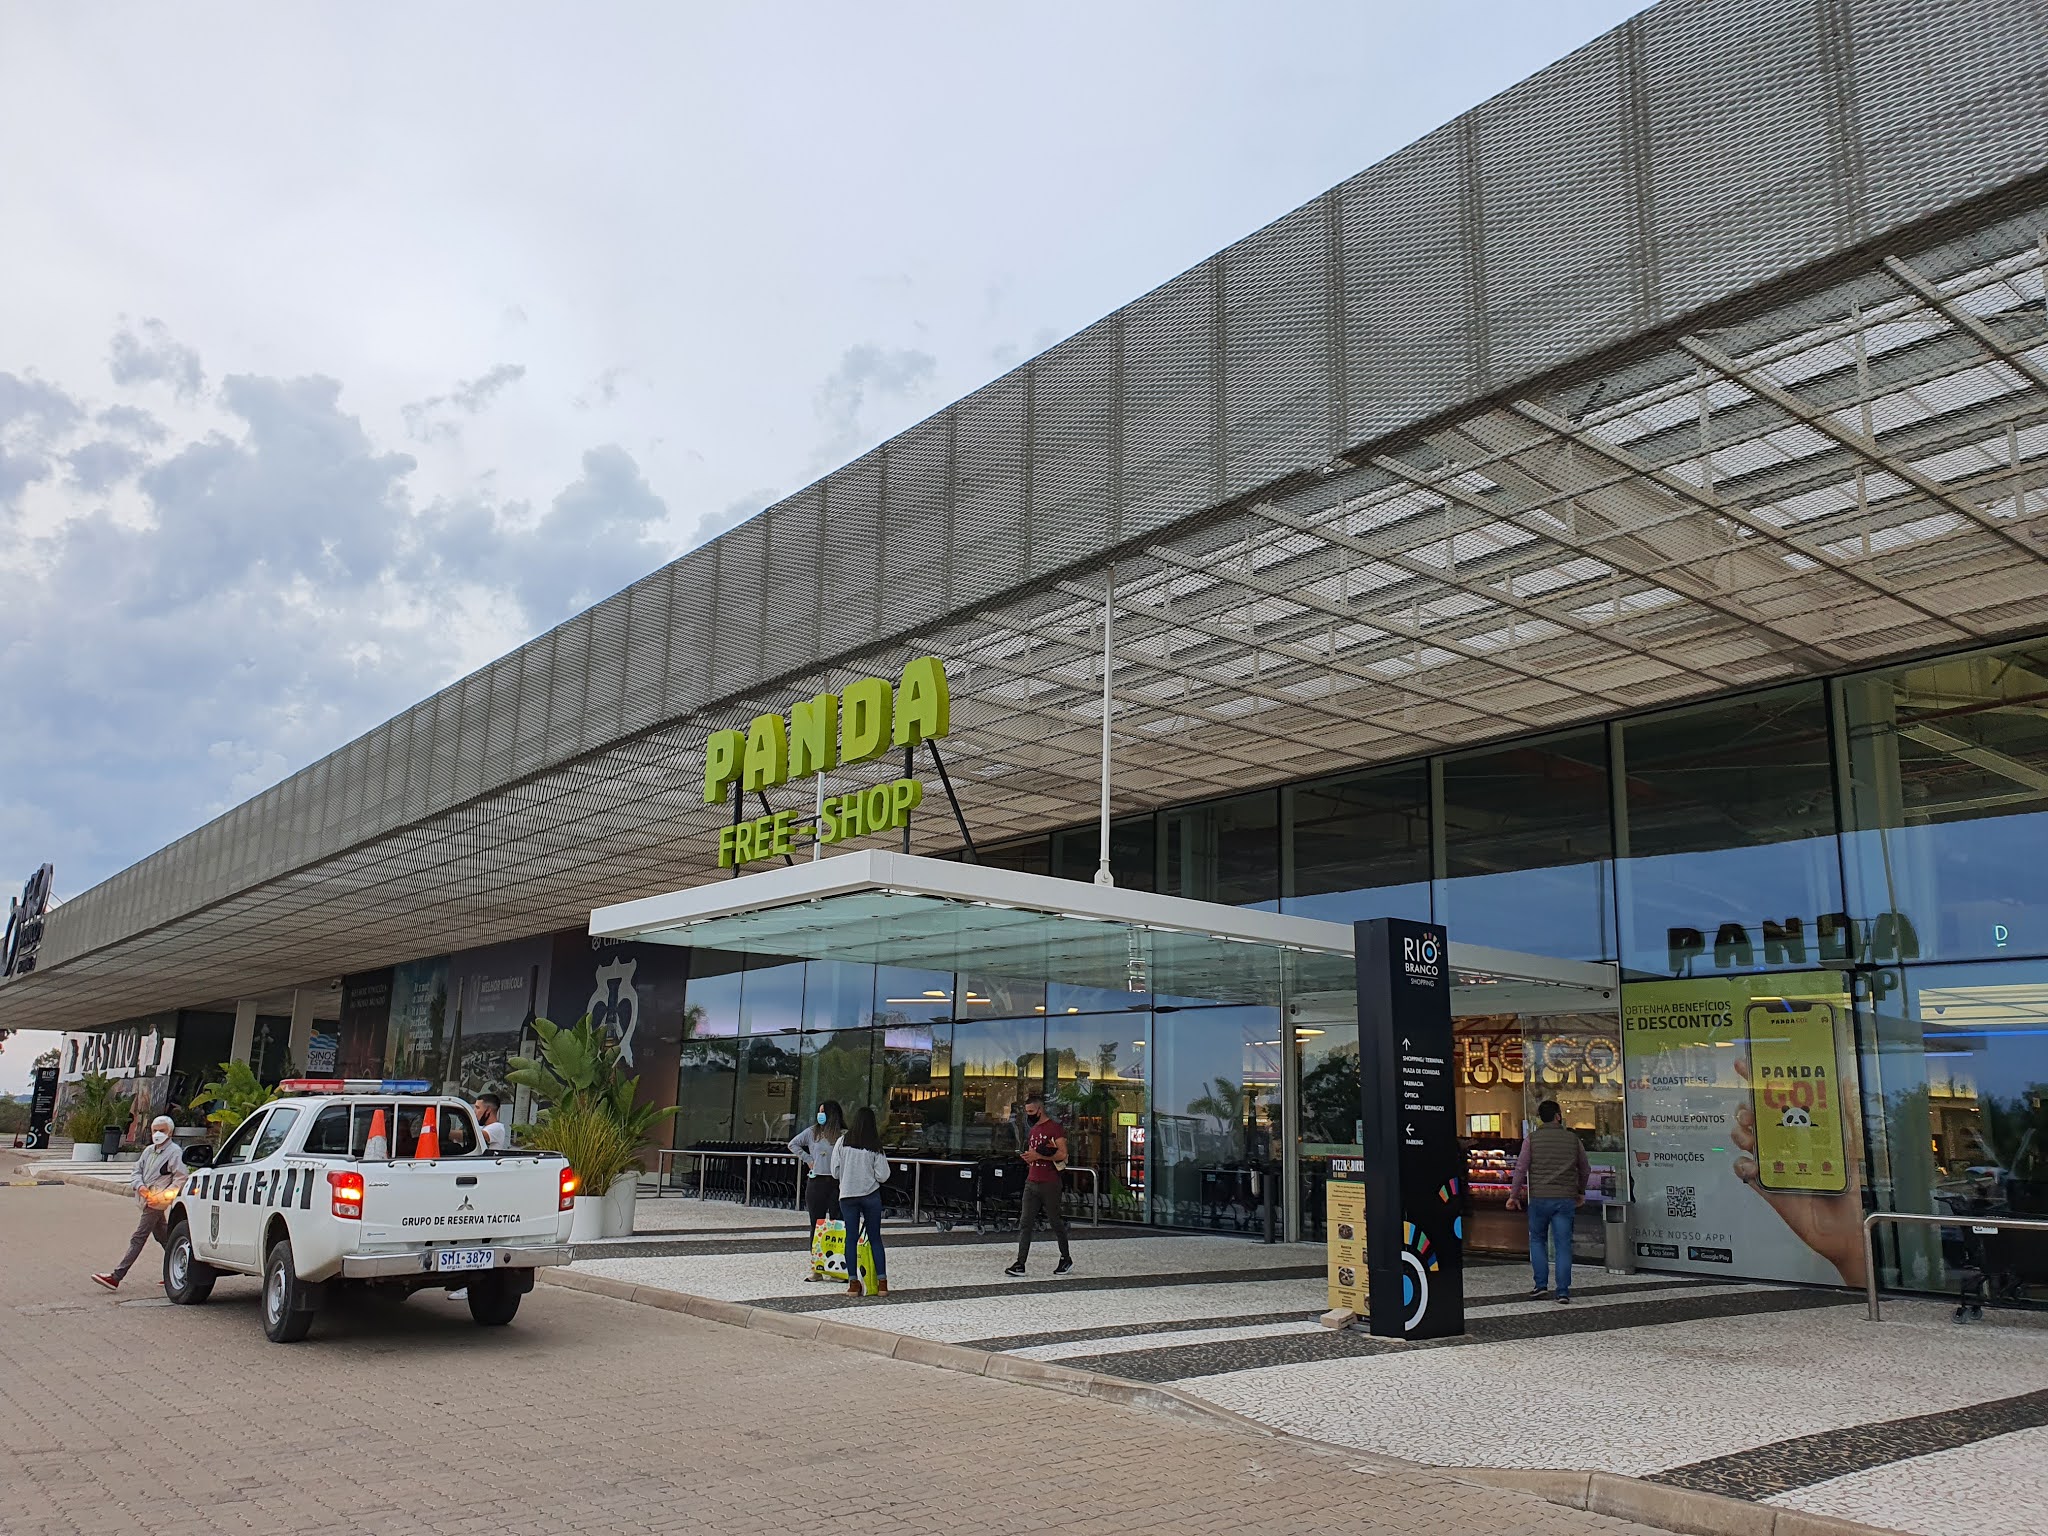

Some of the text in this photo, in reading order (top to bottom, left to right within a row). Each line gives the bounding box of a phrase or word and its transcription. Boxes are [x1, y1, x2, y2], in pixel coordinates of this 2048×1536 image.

[704, 656, 949, 804] PANDA
[1404, 937, 1438, 964] RIO
[1405, 962, 1438, 976] BRANCO
[1411, 978, 1434, 987] SHOPPING
[1625, 1000, 1731, 1016] OBTENHA BENEFÍCIOS
[1626, 1013, 1733, 1031] E DESCONTOS
[81, 1027, 138, 1073] CASINO
[1761, 1065, 1825, 1078] PANDA
[1652, 1076, 1708, 1085] CADASTRE-SE
[1404, 1091, 1419, 1099] ÓPTICA
[1764, 1080, 1828, 1110] GO!
[1650, 1114, 1725, 1124] ACUMULE PONTOS
[1654, 1152, 1705, 1163] PROMOÇÕES
[402, 1213, 521, 1227] GRUPO DE RESERVA TÁCTICA
[1635, 1228, 1663, 1238] BAIXE
[1667, 1231, 1701, 1241] NOSSO
[1661, 1249, 1675, 1257] Store
[1701, 1252, 1730, 1262] Google Play
